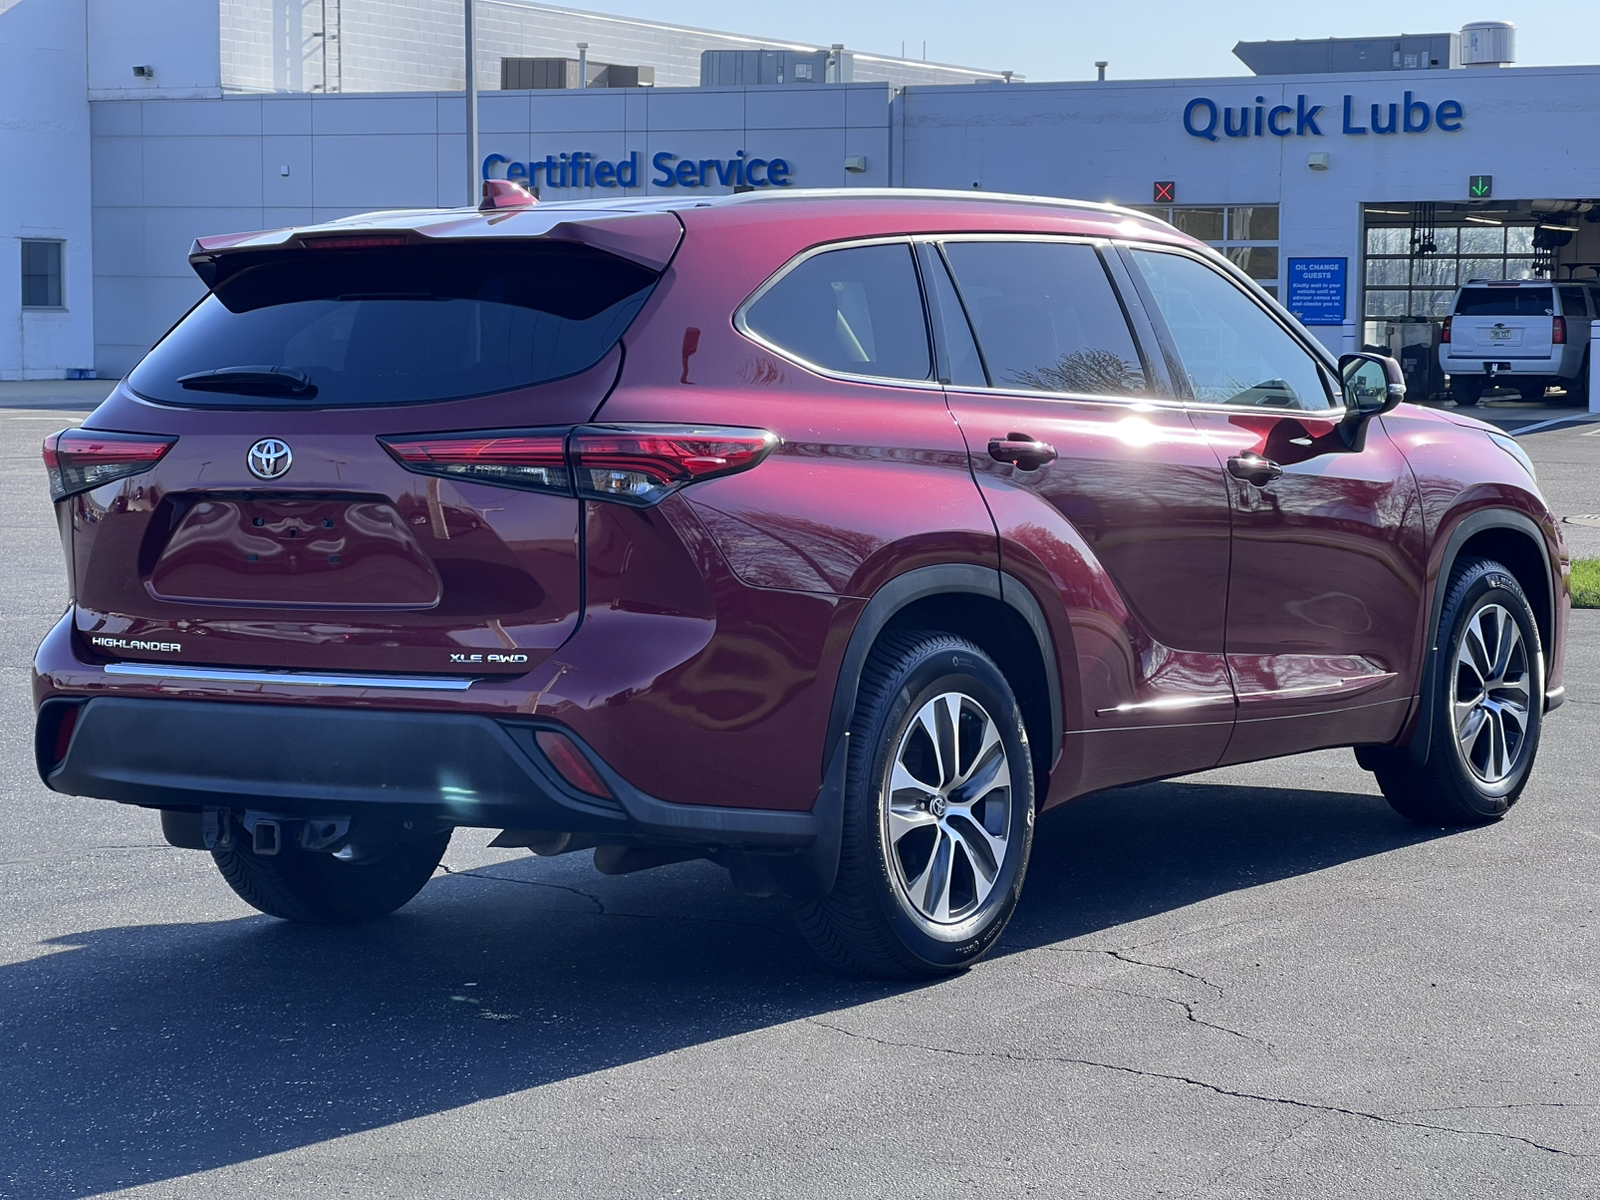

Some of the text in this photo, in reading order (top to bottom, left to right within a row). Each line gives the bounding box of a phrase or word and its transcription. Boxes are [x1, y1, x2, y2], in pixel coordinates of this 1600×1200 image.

[1183, 91, 1465, 141] Quick Lube
[482, 150, 791, 188] Certified Service
[92, 636, 182, 652] HIGHLANDER
[449, 653, 528, 663] XLE AWD
